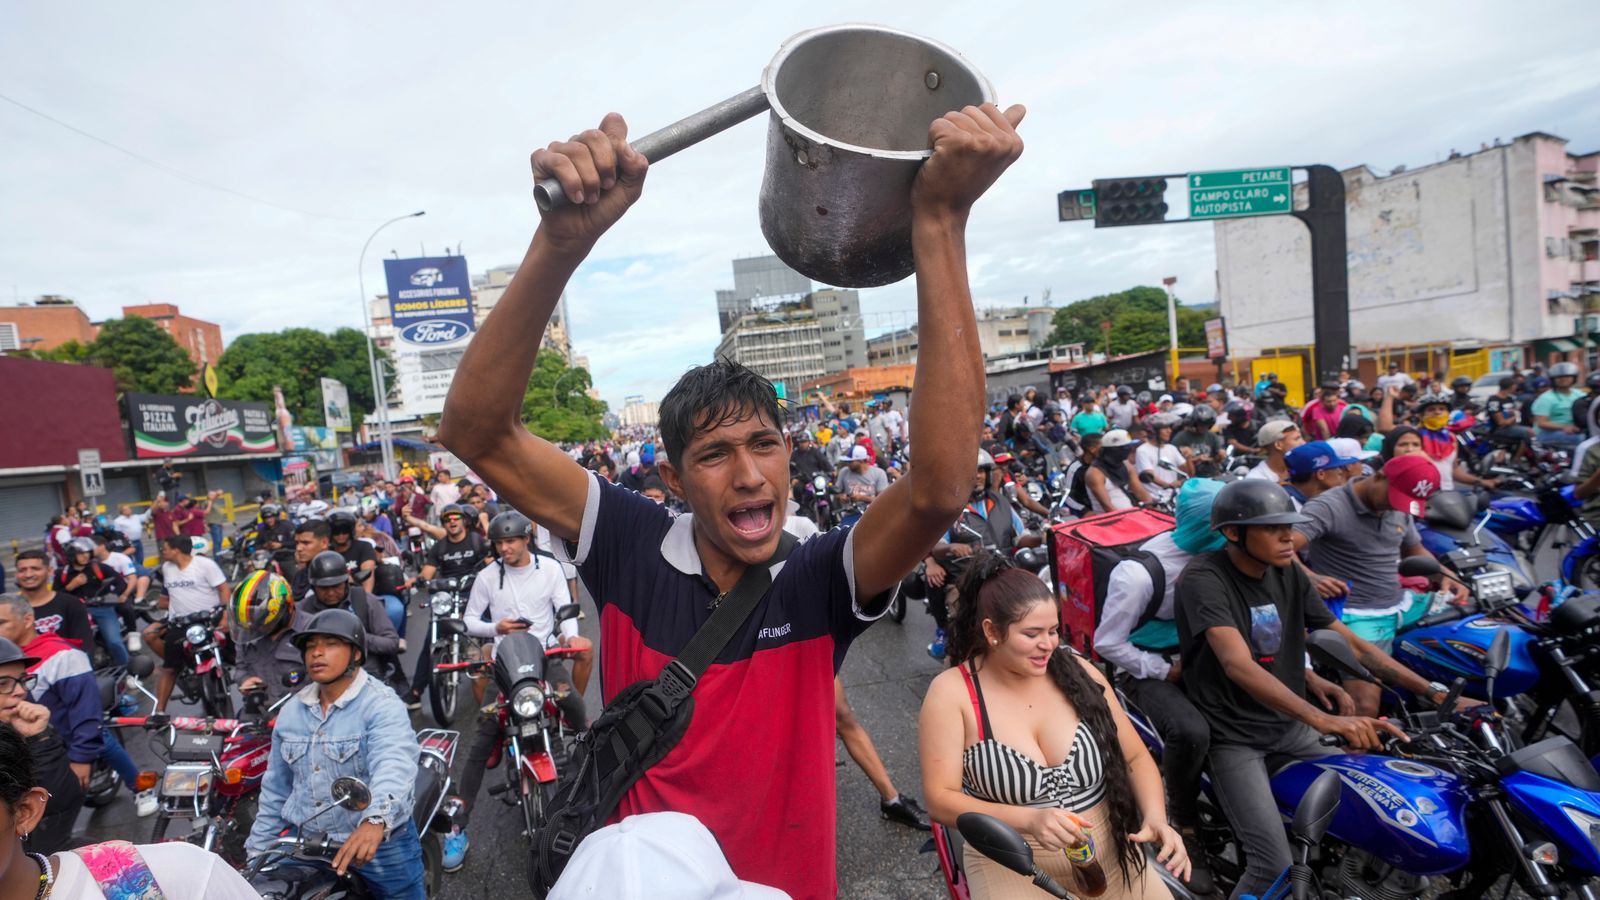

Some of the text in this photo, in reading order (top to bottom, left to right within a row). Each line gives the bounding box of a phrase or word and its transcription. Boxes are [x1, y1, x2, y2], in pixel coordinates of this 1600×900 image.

[1242, 171, 1282, 182] PETARE
[1193, 188, 1269, 202] CAMPO CLARO
[1194, 201, 1252, 214] AUTOPISTA
[394, 298, 468, 311] SOMOS LÍDERES
[413, 323, 457, 343] Ford
[143, 412, 174, 422] PIZZA
[143, 422, 178, 432] ITALIANA
[1347, 770, 1405, 807] EMPIRE
[1355, 782, 1398, 811] KEEWAY
